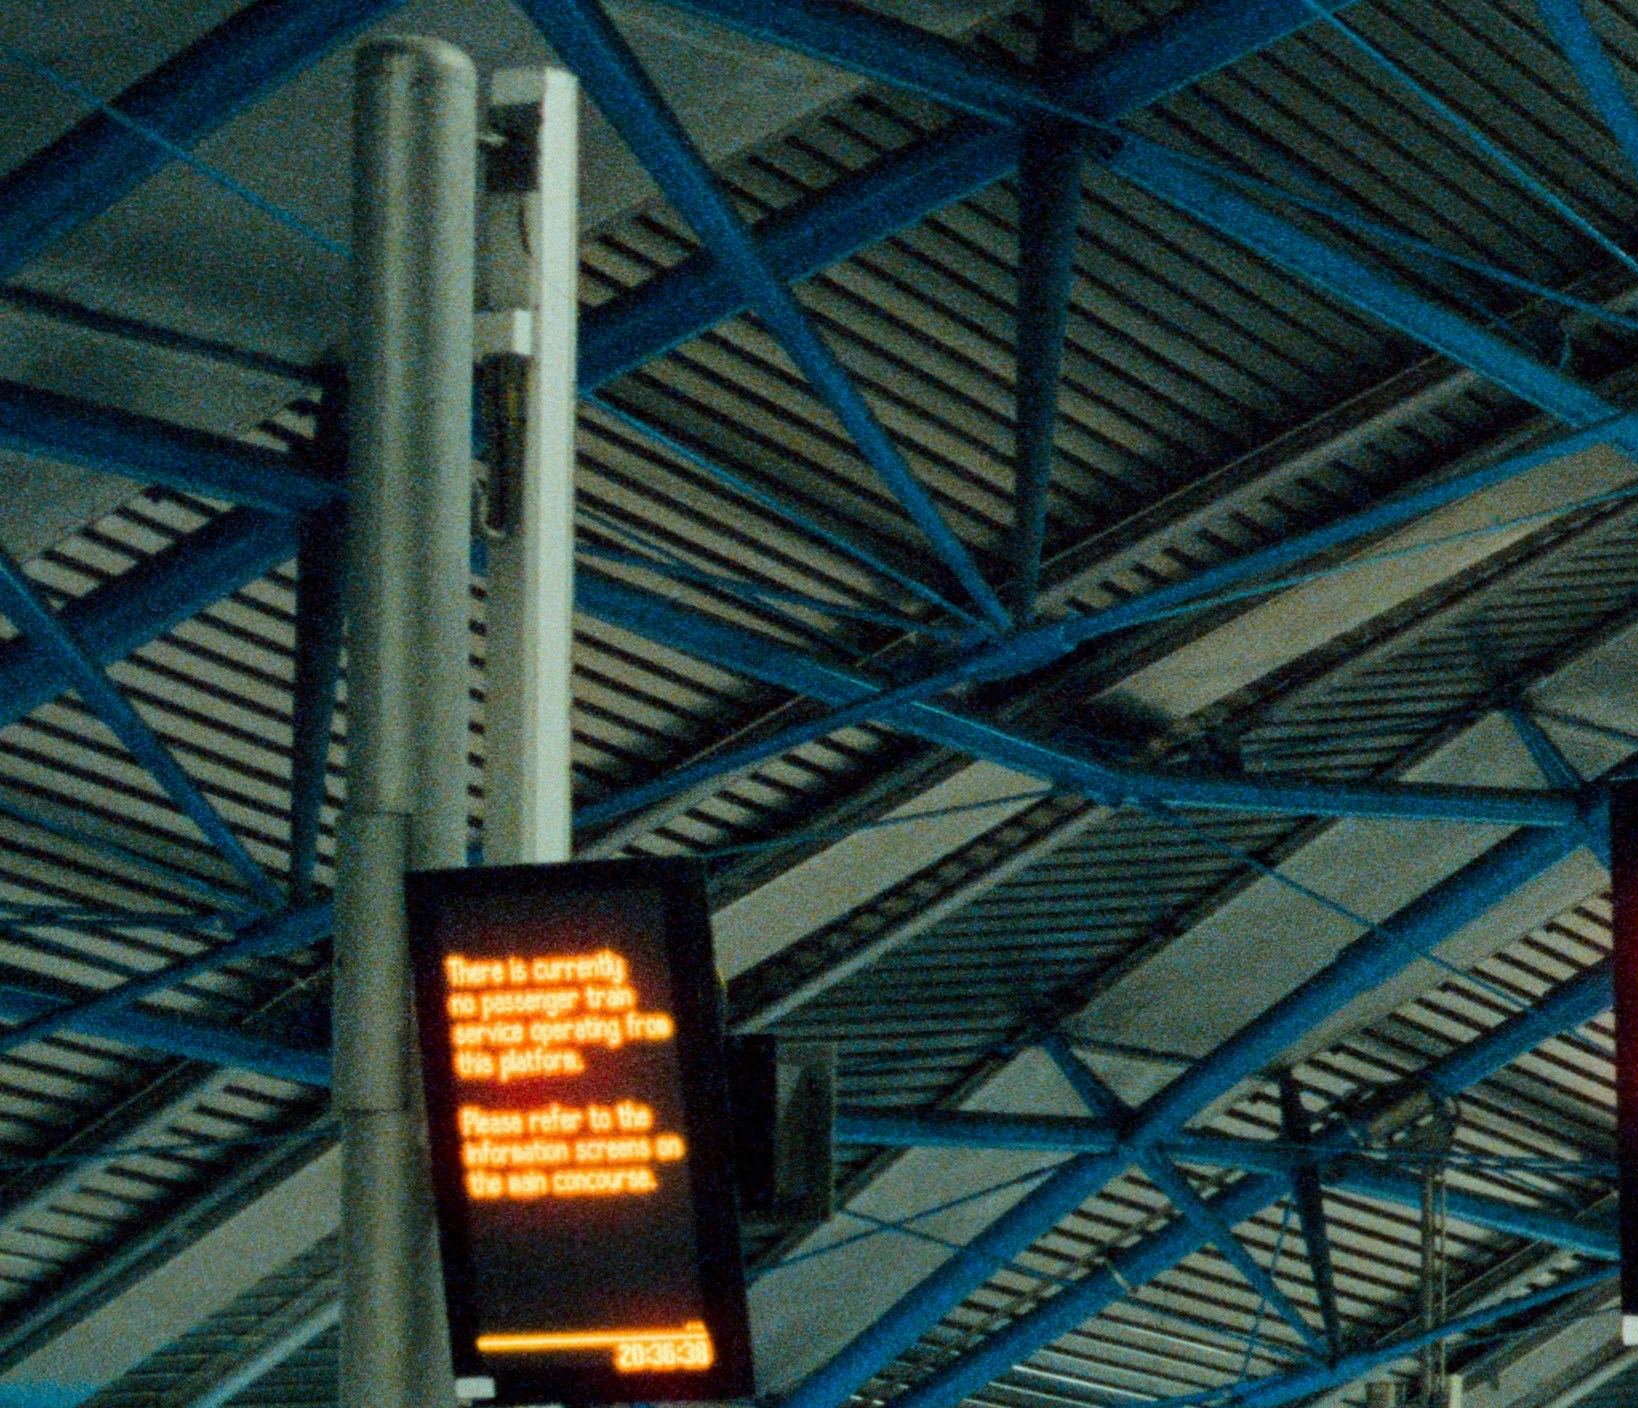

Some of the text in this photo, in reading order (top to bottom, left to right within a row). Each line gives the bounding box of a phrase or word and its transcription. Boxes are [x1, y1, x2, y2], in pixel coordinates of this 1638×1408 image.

[448, 949, 626, 985] There is currently
[450, 986, 636, 1020] no passenger train
[454, 1011, 673, 1049] service operating from
[456, 1047, 585, 1081] this platform.
[460, 1100, 652, 1136] Please refer to the
[465, 1134, 683, 1166] information screens on
[469, 1167, 658, 1198] the main concourse.
